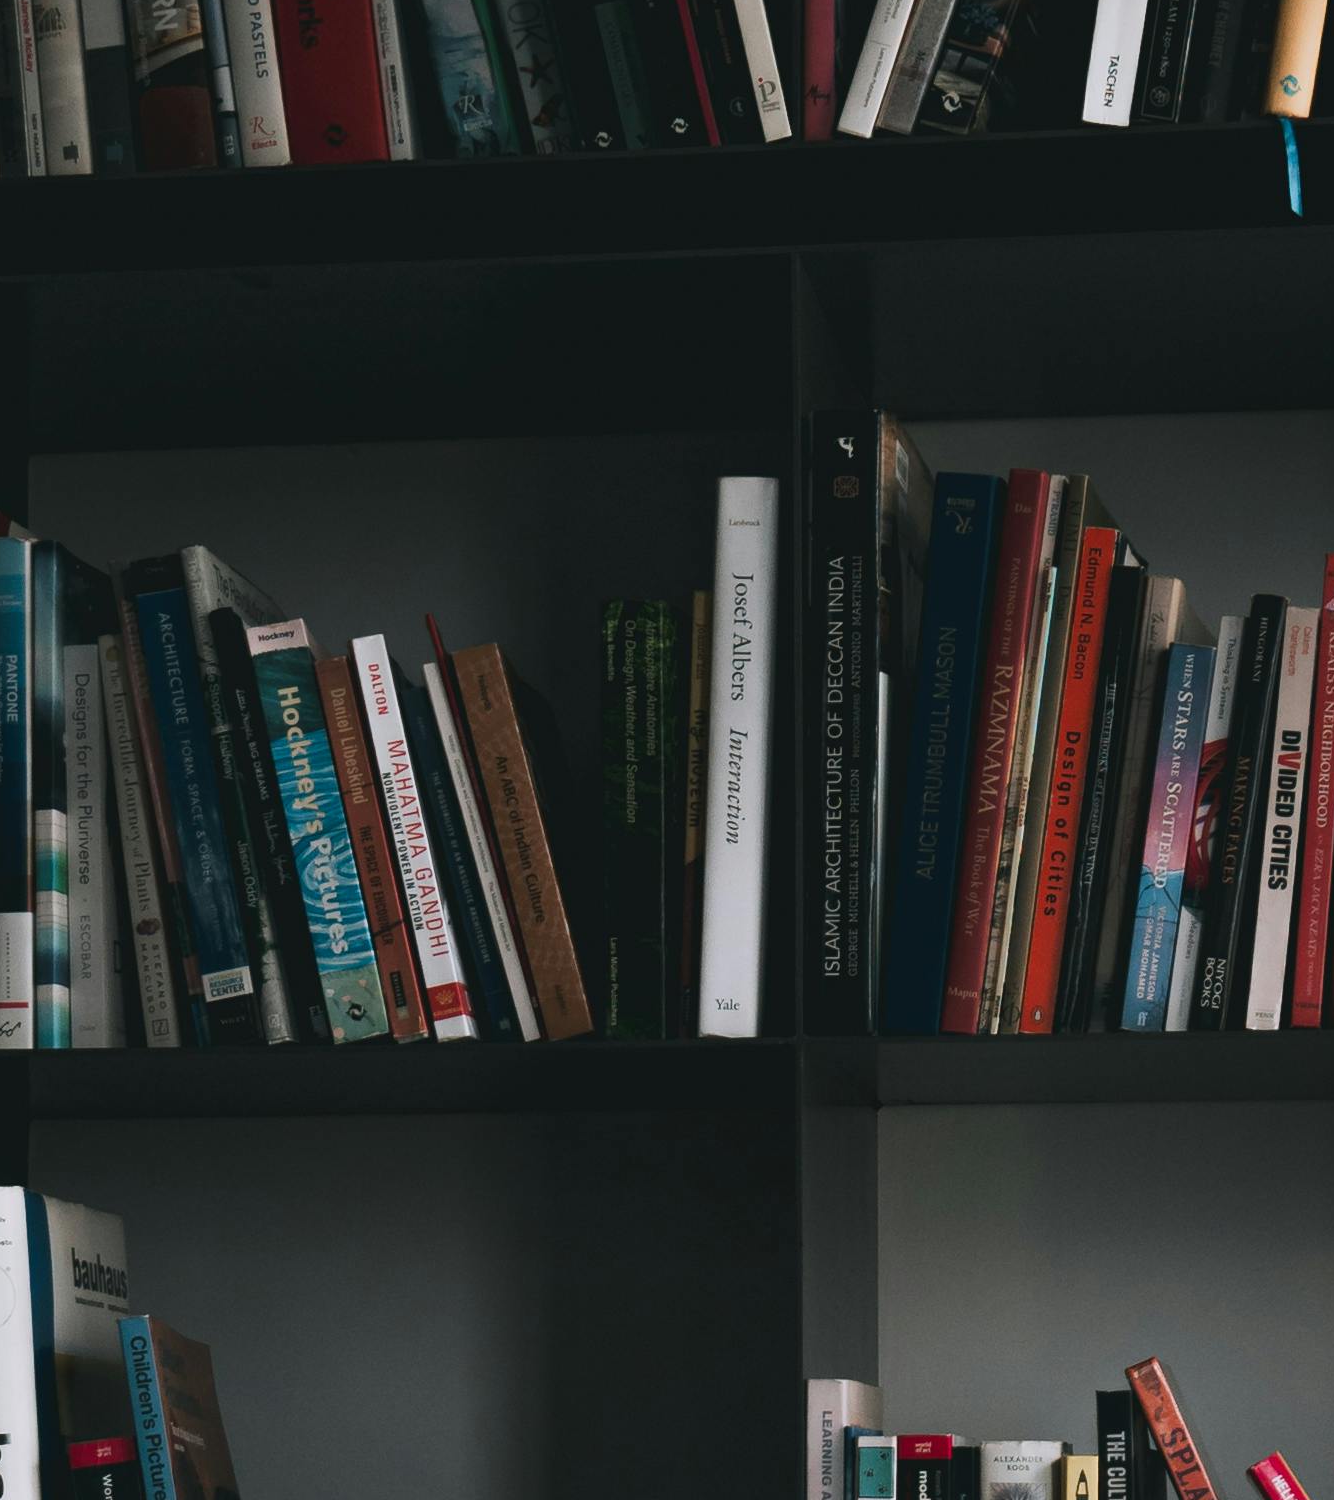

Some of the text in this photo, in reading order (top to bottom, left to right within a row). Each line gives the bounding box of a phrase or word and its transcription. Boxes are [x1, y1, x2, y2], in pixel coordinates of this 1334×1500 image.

[5, 654, 18, 722] PANTONE
[368, 663, 389, 716] DALTON
[724, 573, 754, 845] Josef Albers Interaction
[976, 664, 1014, 814] RAZMNAMA
[276, 686, 349, 955] Hockney's Pictures
[387, 739, 448, 957] MAHATMA GANDHI
[1044, 731, 1082, 918] Design of Cities
[1267, 730, 1302, 890] DIVIDED CITIES
[1107, 1432, 1127, 1462] THE
